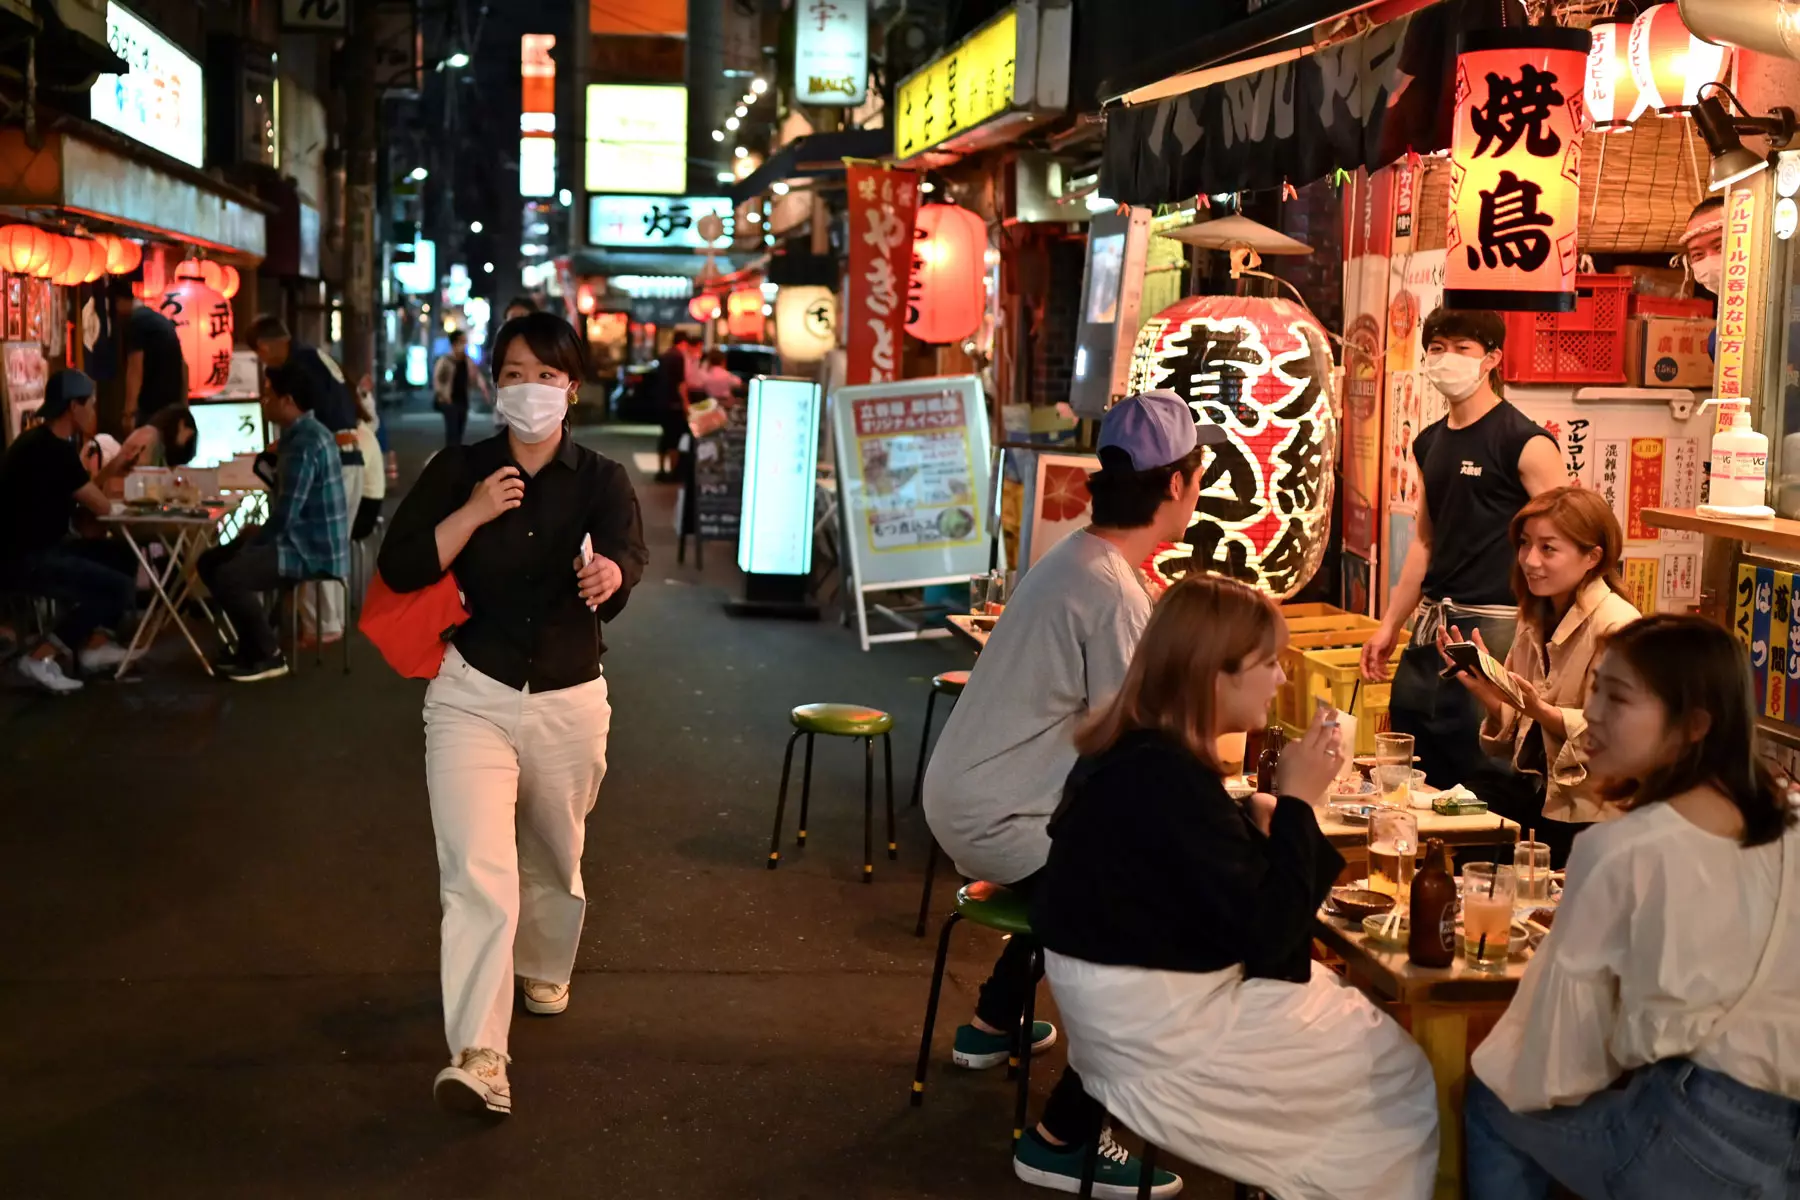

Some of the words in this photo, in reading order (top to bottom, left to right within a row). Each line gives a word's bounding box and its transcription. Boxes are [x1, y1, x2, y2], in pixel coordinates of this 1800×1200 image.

[1591, 32, 1606, 100] キリンビール
[1467, 64, 1564, 272] 焼鳥
[1752, 457, 1765, 466] VG
[1737, 576, 1753, 648] つく
[1752, 581, 1771, 668] はつ
